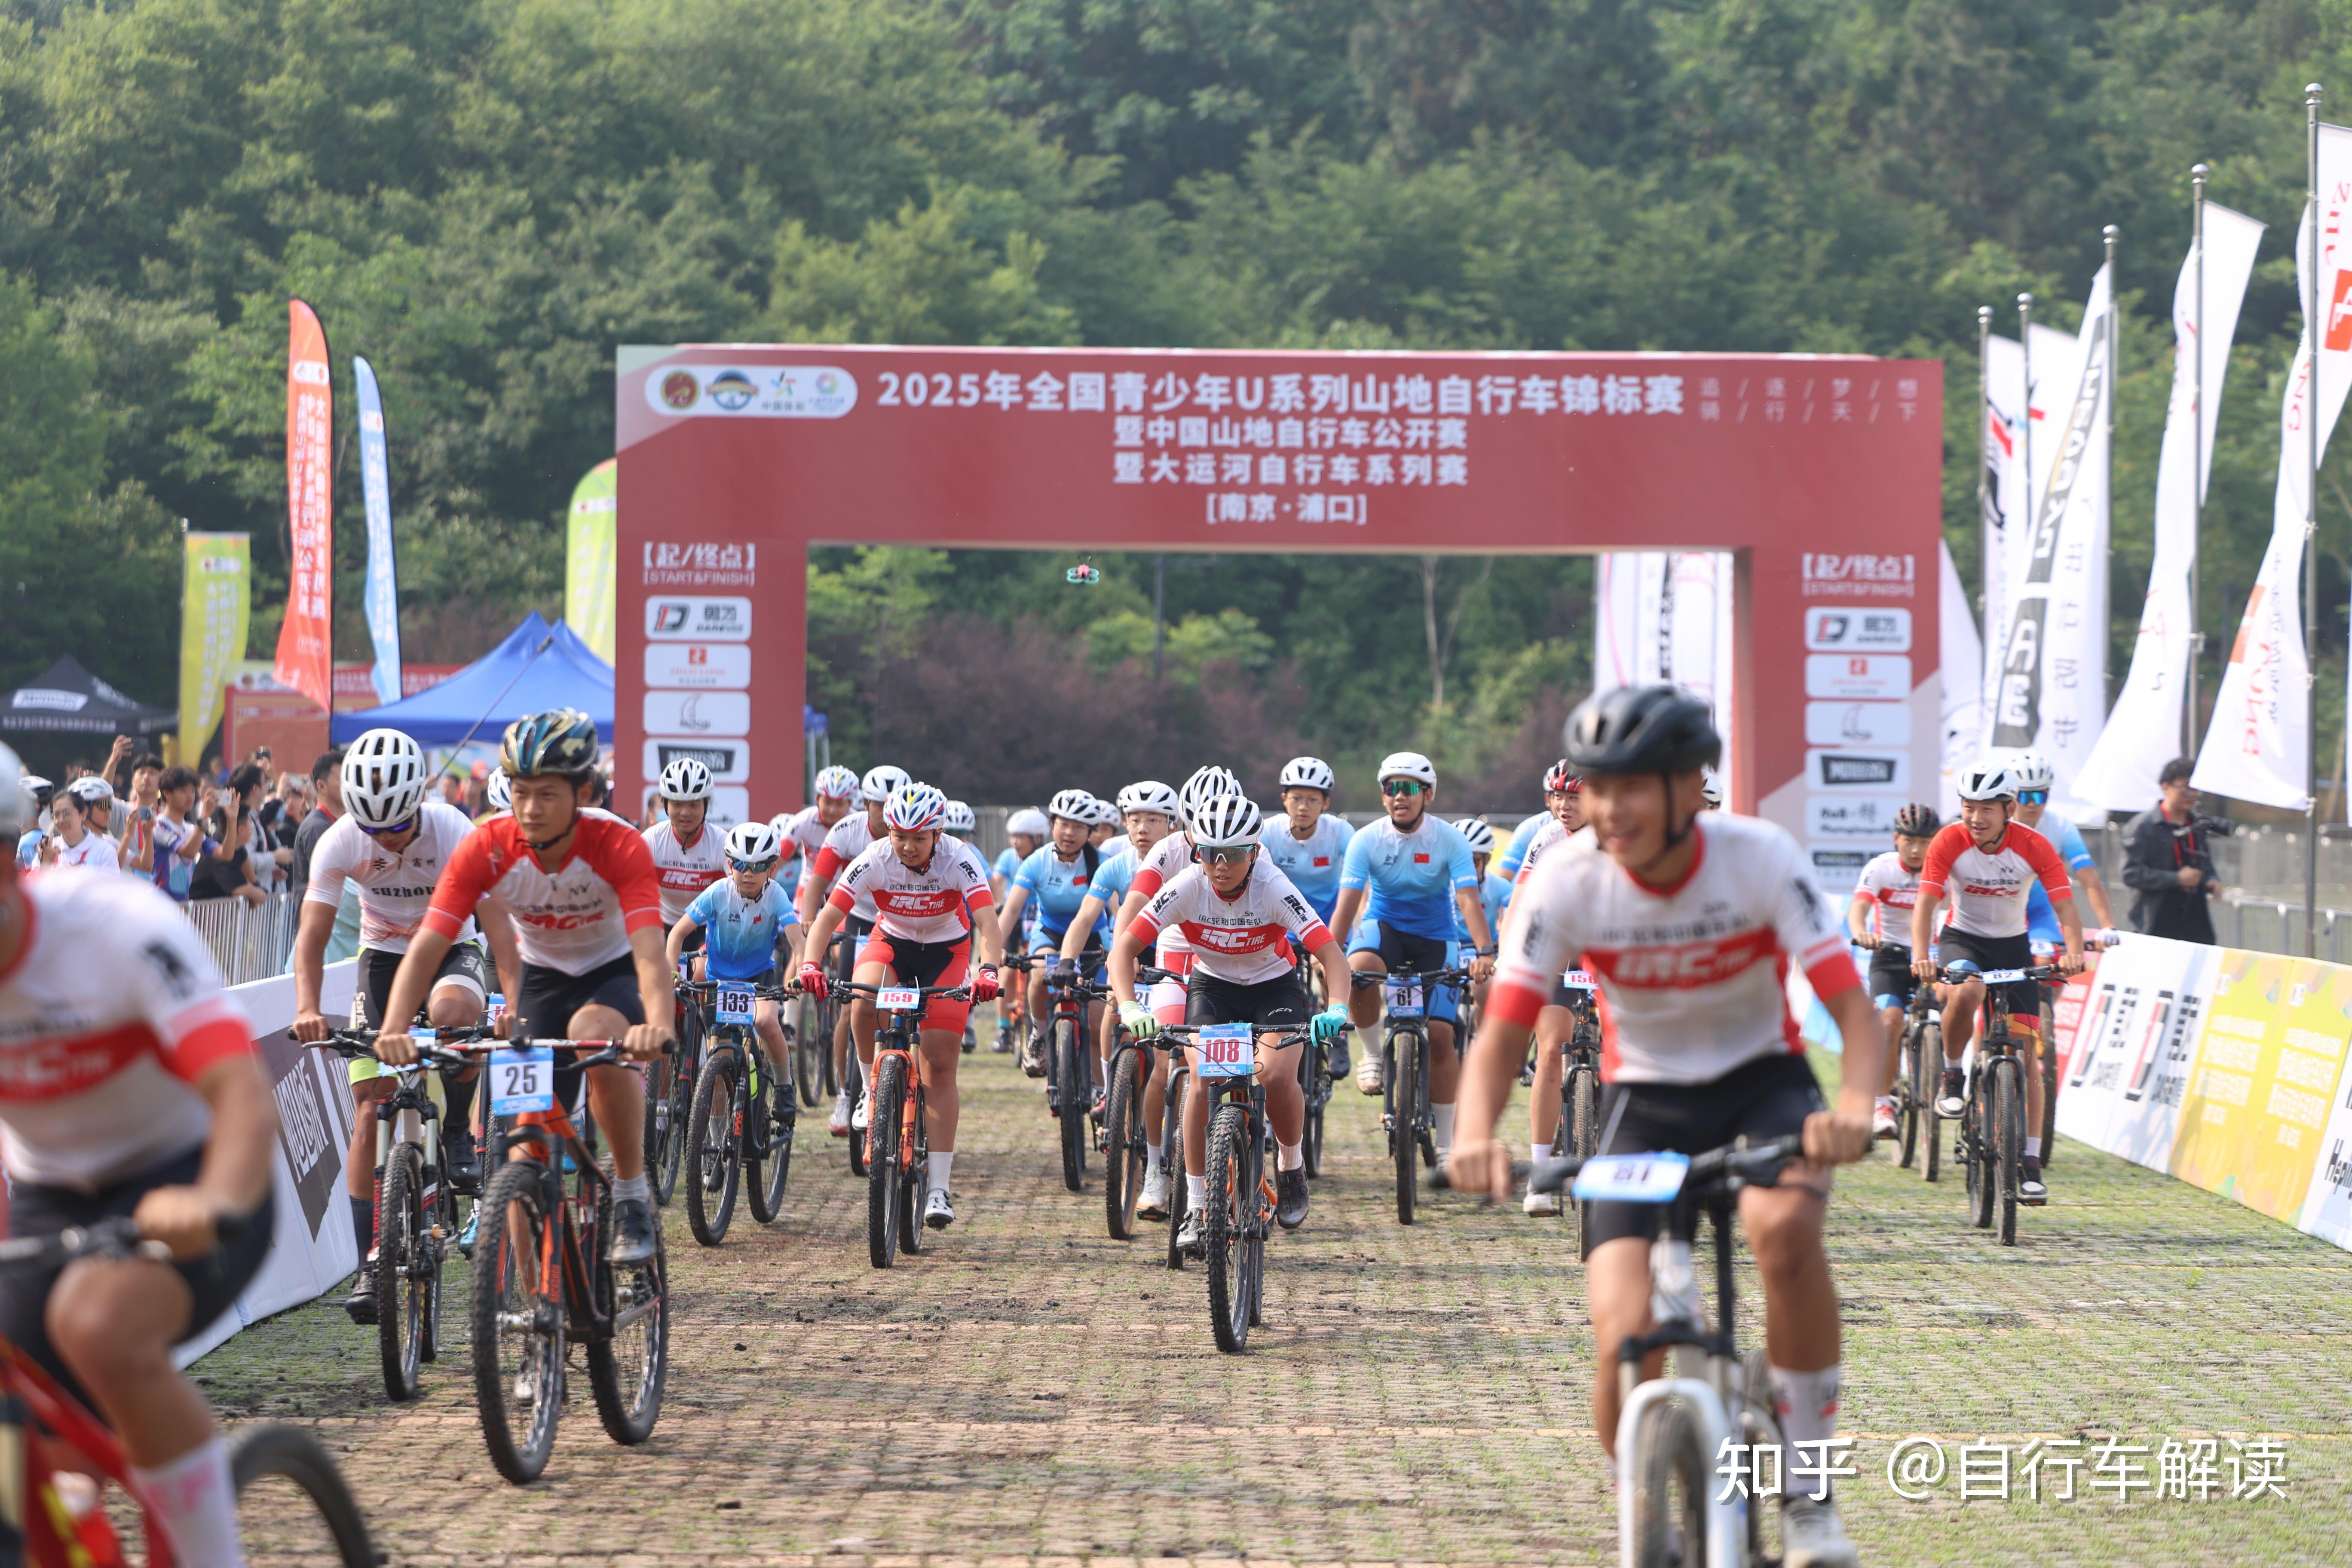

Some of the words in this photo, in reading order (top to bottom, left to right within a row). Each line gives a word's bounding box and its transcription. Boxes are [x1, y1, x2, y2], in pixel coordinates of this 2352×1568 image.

[877, 370, 1684, 414] 2025年全国青少年U系列山地自行车锦标赛
[1113, 415, 1468, 449] 暨中国山地自行车公开赛
[1113, 451, 1468, 486] 暨大运河自行车系列赛
[663, 870, 700, 885] IRC
[847, 864, 863, 885] IRC
[959, 861, 977, 879] IRC
[889, 895, 931, 910] IRC
[929, 898, 945, 909] TIRE
[1153, 891, 1170, 913] IRC
[1168, 888, 1178, 899] TIRE
[1283, 894, 1307, 916] IRC
[1299, 913, 1309, 923] TIRE
[1198, 914, 1263, 926] IRC轮胎中国车队
[1200, 928, 1249, 947] IRC
[1246, 933, 1267, 946] TIRE
[723, 991, 748, 1013] 133
[883, 992, 913, 1003] 159
[1396, 987, 1412, 1007] 61
[1205, 1038, 1240, 1063] 108
[505, 1063, 537, 1096] 25
